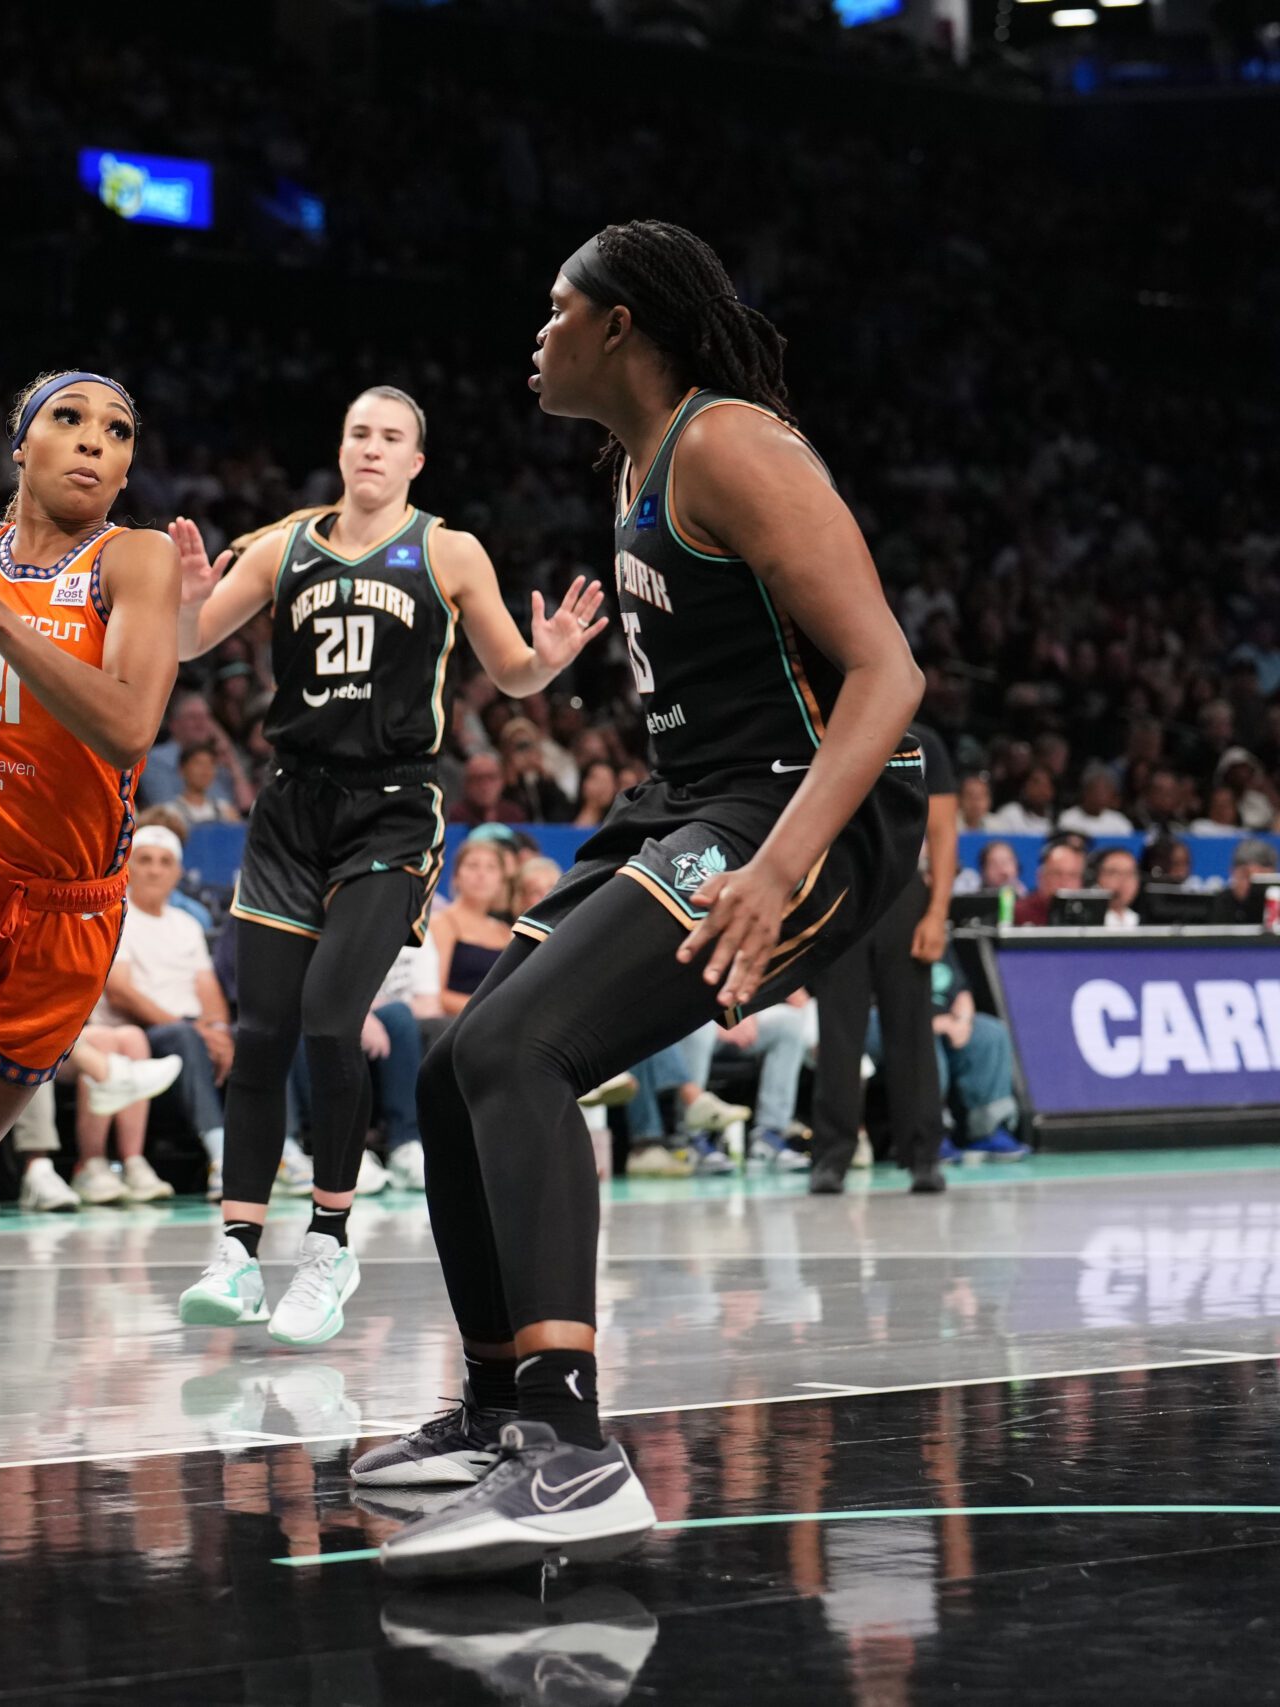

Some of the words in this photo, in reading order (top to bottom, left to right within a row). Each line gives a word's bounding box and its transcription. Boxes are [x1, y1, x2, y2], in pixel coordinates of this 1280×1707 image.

[56, 588, 84, 599] Post
[290, 579, 337, 633] NEW
[354, 578, 416, 629] YORK
[313, 614, 375, 676] 20
